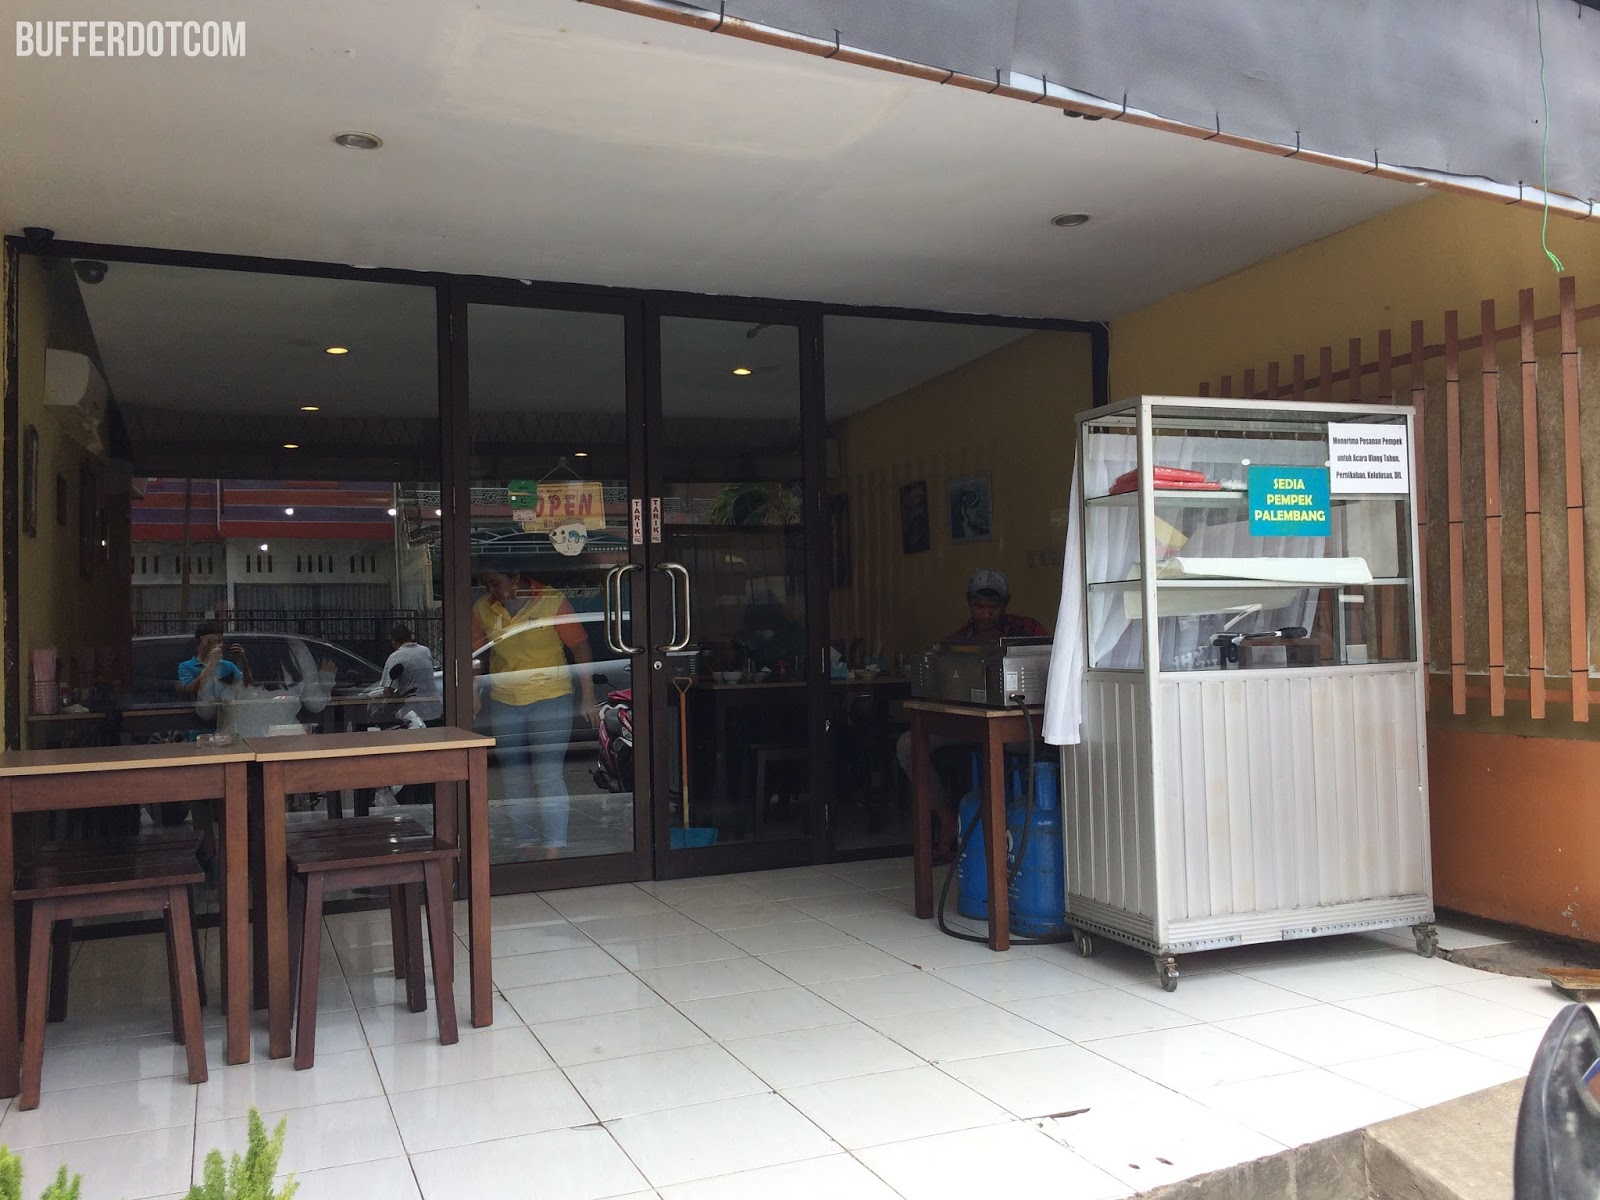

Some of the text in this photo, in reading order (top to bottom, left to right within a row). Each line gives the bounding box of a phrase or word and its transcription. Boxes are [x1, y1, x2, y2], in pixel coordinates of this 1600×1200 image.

[1332, 437, 1403, 446] Menerima Pesanan Pempek
[1337, 454, 1352, 462] untuk
[1353, 454, 1367, 462] Acara
[1368, 454, 1383, 463] Ulang
[1273, 478, 1306, 490] SEDIA
[1266, 493, 1313, 506] PEMPEK
[633, 501, 641, 535] TARIK
[652, 499, 660, 533] TARIK
[1254, 509, 1326, 522] PALEMBANG
